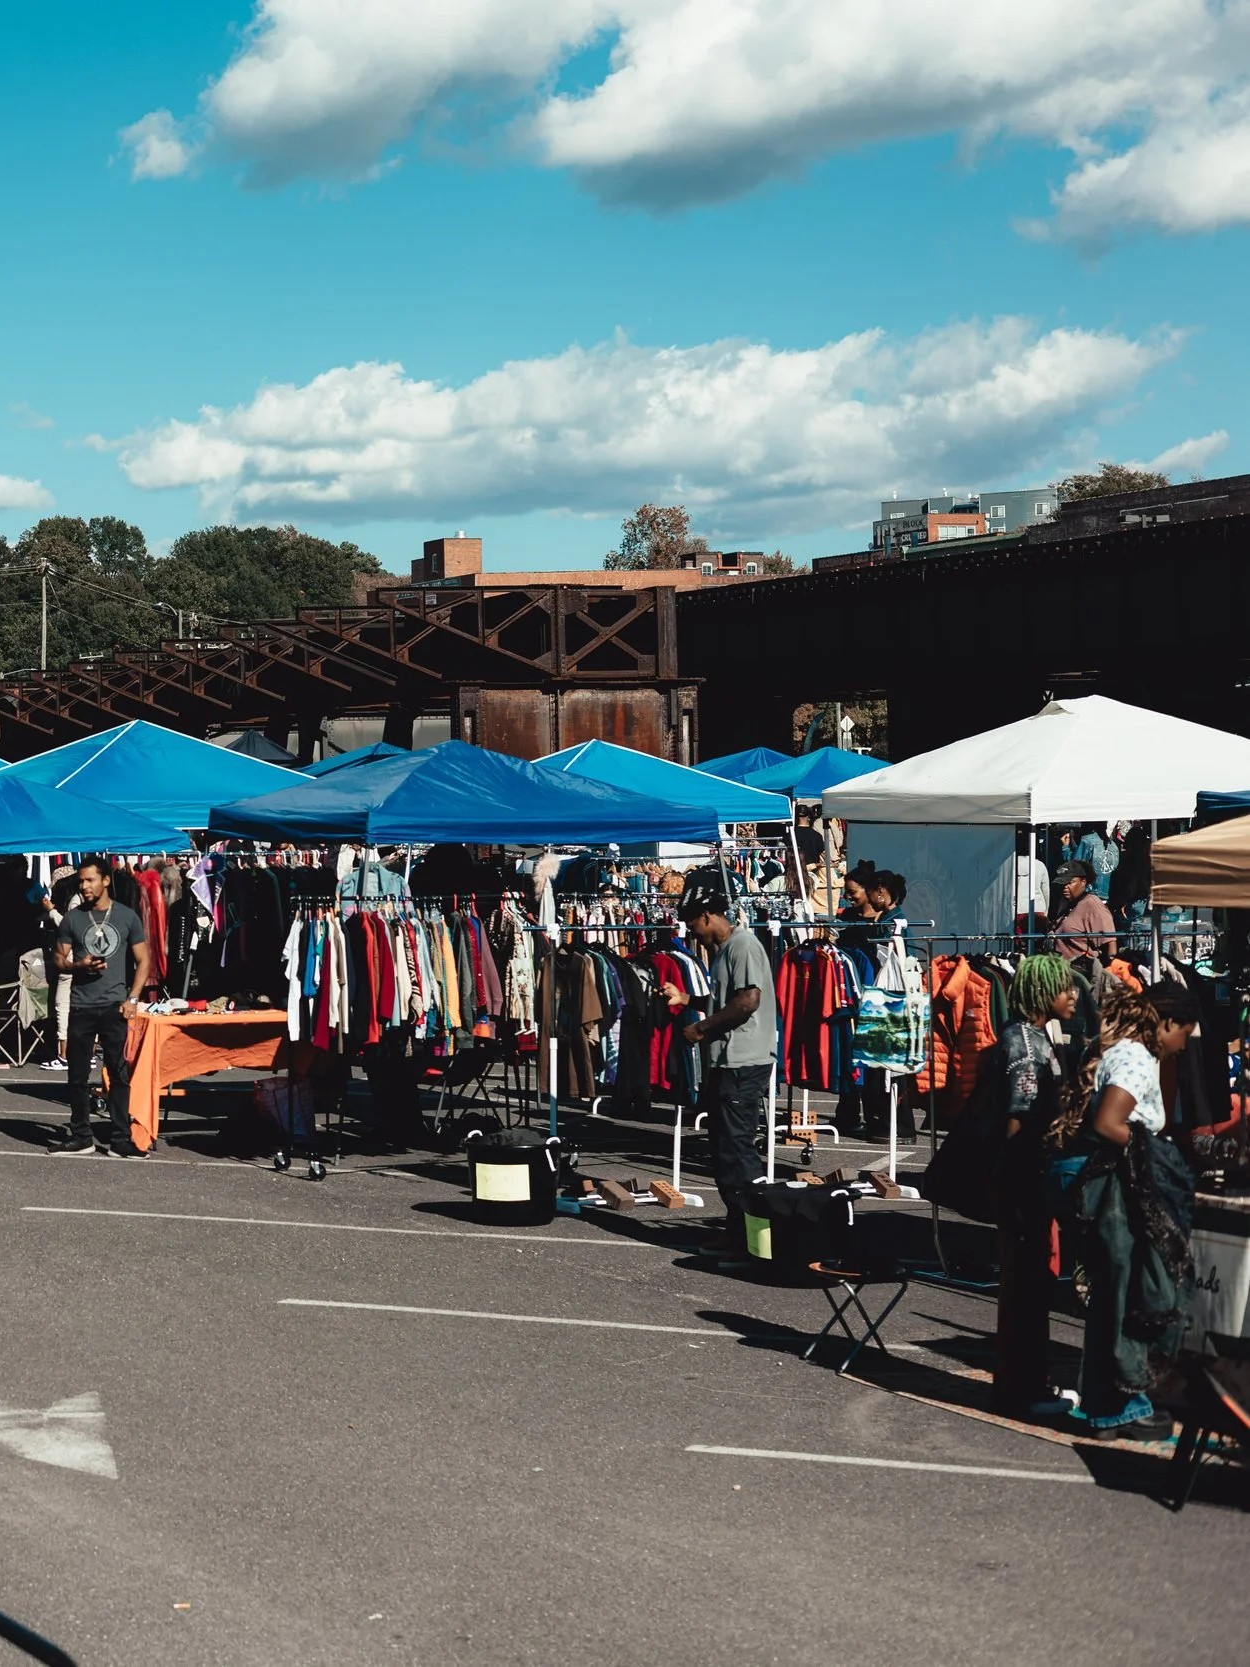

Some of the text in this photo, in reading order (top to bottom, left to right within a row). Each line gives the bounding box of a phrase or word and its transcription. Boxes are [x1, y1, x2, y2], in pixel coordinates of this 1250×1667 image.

[902, 519, 924, 529] BLOCK
[901, 531, 927, 542] CRUED
[1196, 1264, 1221, 1294] ads
